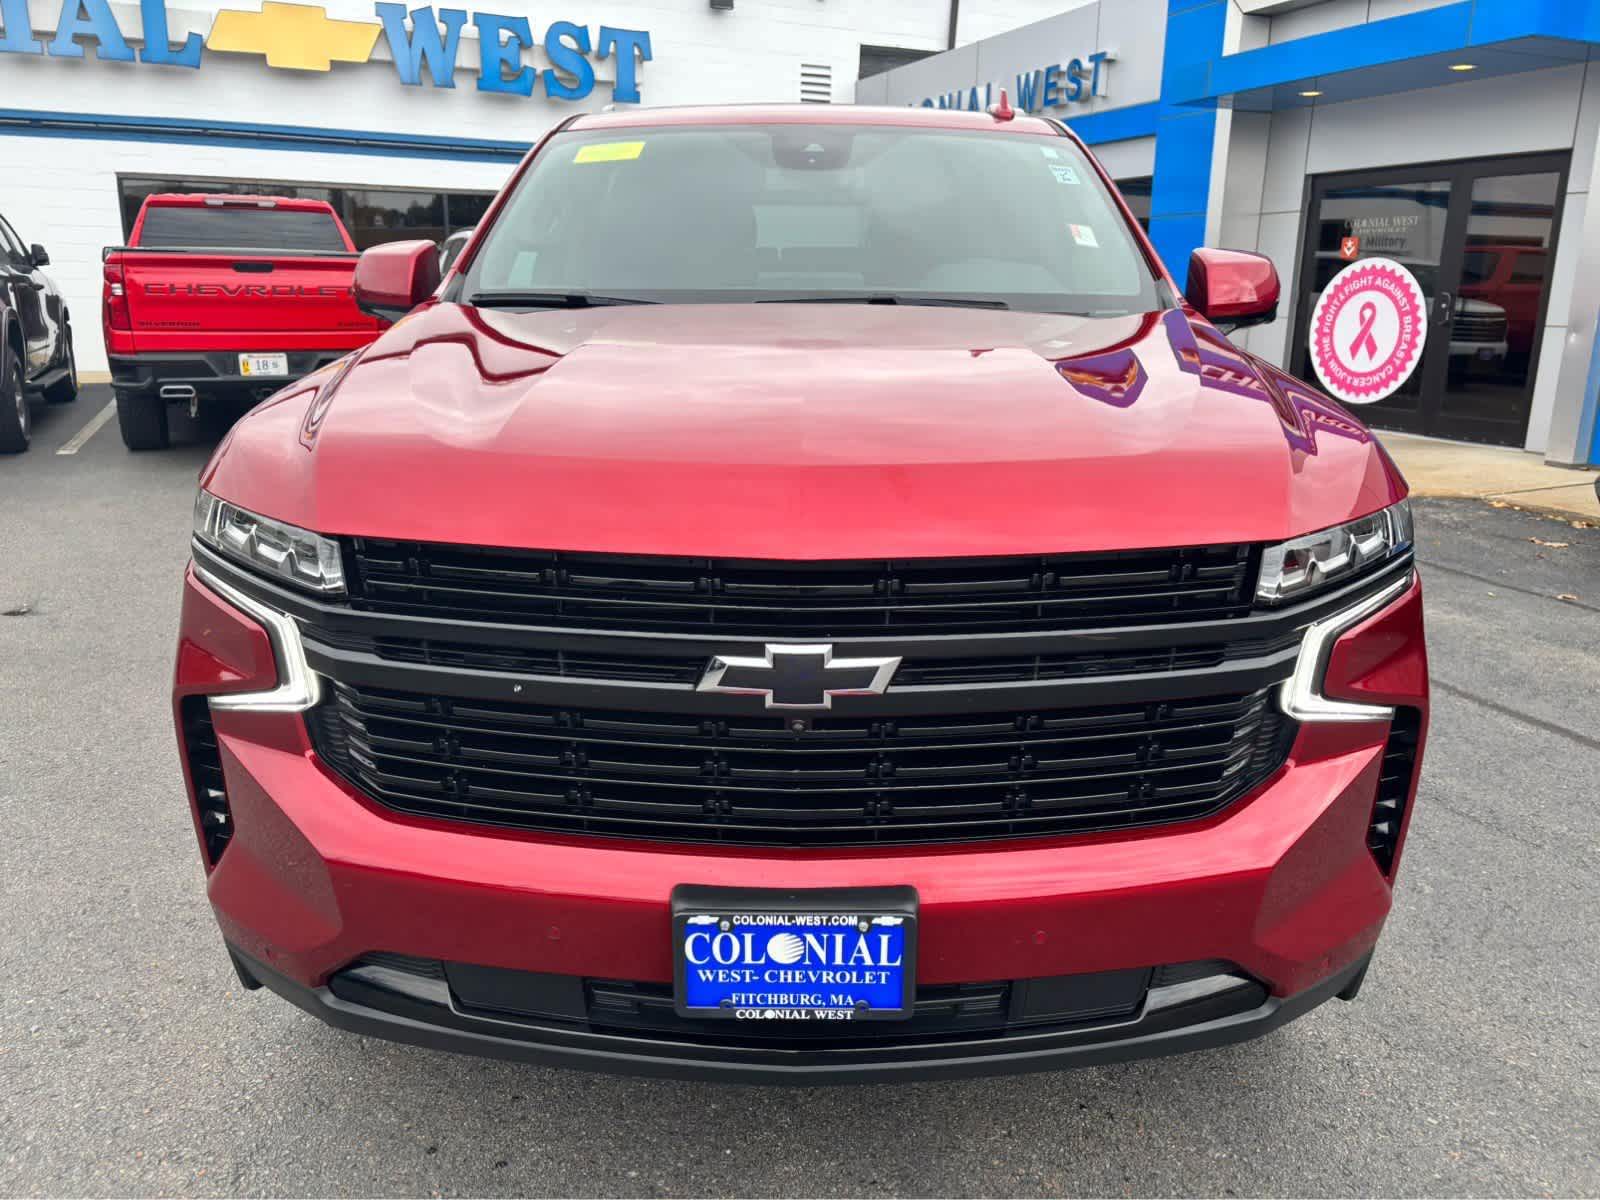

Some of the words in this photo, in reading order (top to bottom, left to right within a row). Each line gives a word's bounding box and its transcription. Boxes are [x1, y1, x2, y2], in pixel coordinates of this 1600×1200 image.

[375, 1, 653, 104] WEST
[1016, 51, 1108, 114] WEST
[1344, 276, 1373, 295] FIGHT
[1375, 276, 1410, 312] AGAINST
[1323, 298, 1340, 333] FIGHT
[1322, 337, 1332, 360] THE
[1393, 315, 1412, 367] BREAST
[1352, 365, 1393, 387] CANCER
[732, 915, 858, 926] COLONIAL-WEST.COM
[684, 932, 902, 966] COLONIAL
[764, 969, 890, 984] CHEVROLET
[731, 992, 826, 1007] FITCHBURG,
[830, 993, 854, 1006] MA
[736, 1009, 810, 1020] COLONIAL
[815, 1009, 854, 1020] WEST
